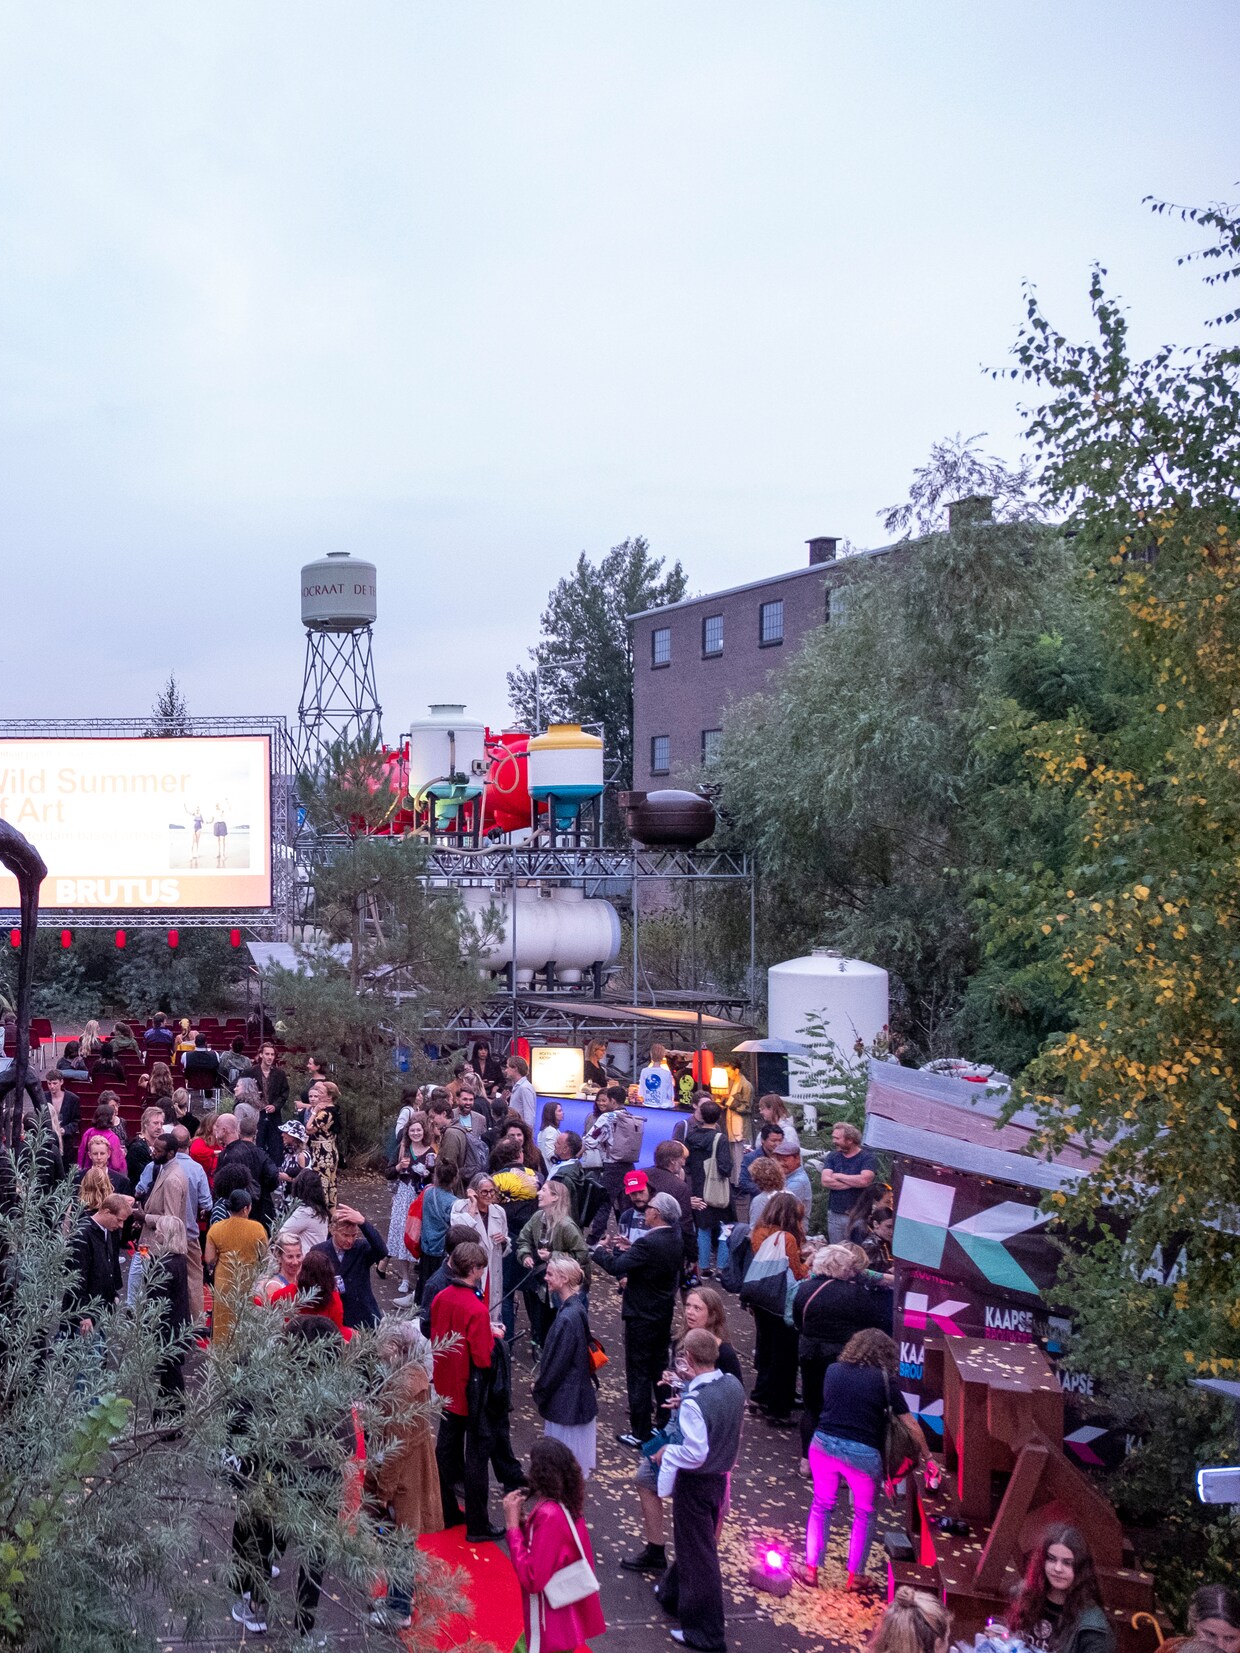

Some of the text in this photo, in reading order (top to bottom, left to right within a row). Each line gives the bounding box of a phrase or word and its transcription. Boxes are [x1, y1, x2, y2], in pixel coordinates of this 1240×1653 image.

[302, 583, 345, 598] OCRAAT
[57, 768, 191, 794] Summer
[17, 797, 65, 823] Art
[56, 878, 180, 904] BRUTUS
[985, 1305, 1033, 1334] KAAPSE
[900, 1341, 925, 1365] KAA
[899, 1361, 924, 1380] BROU
